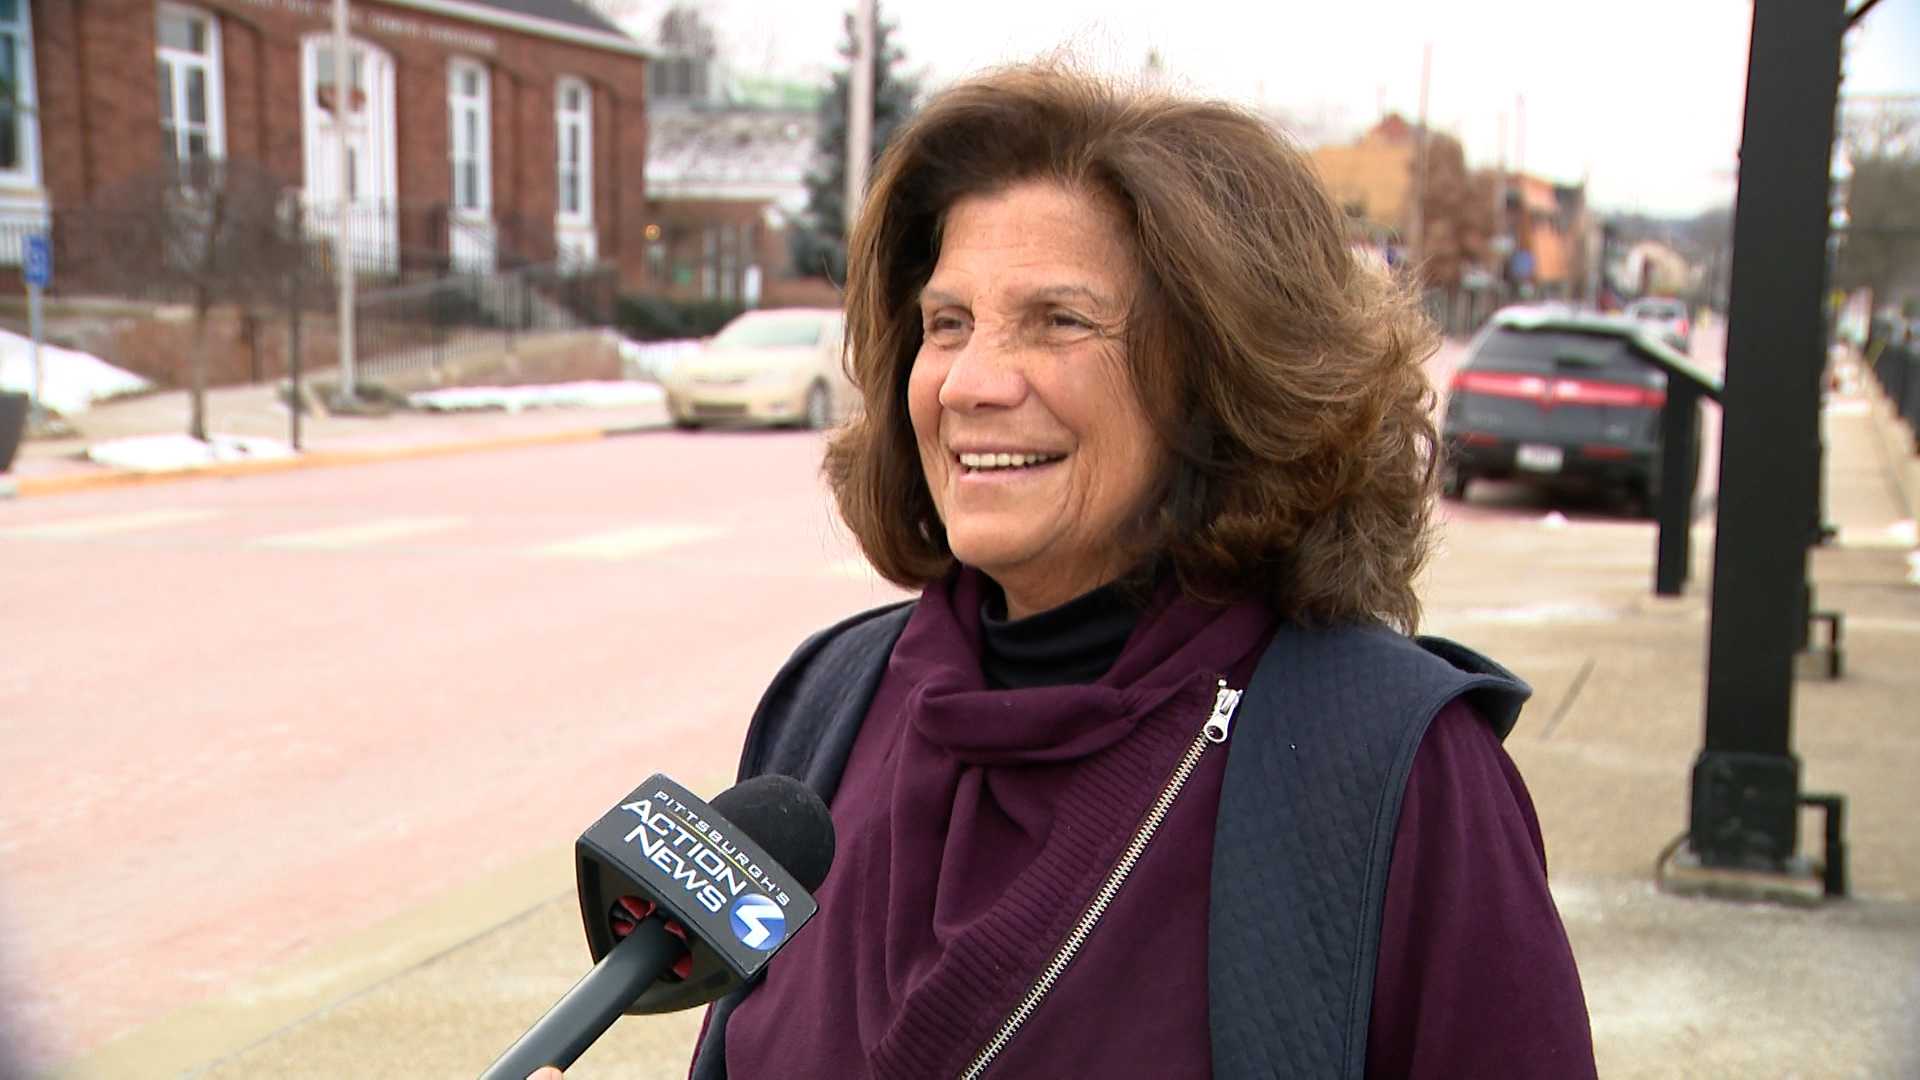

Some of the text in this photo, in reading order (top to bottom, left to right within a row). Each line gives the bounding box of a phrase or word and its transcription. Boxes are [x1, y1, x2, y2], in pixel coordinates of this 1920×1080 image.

[621, 799, 747, 897] ACTION
[623, 824, 728, 914] NEWS
[654, 790, 791, 907] PITTSBURGH'S
